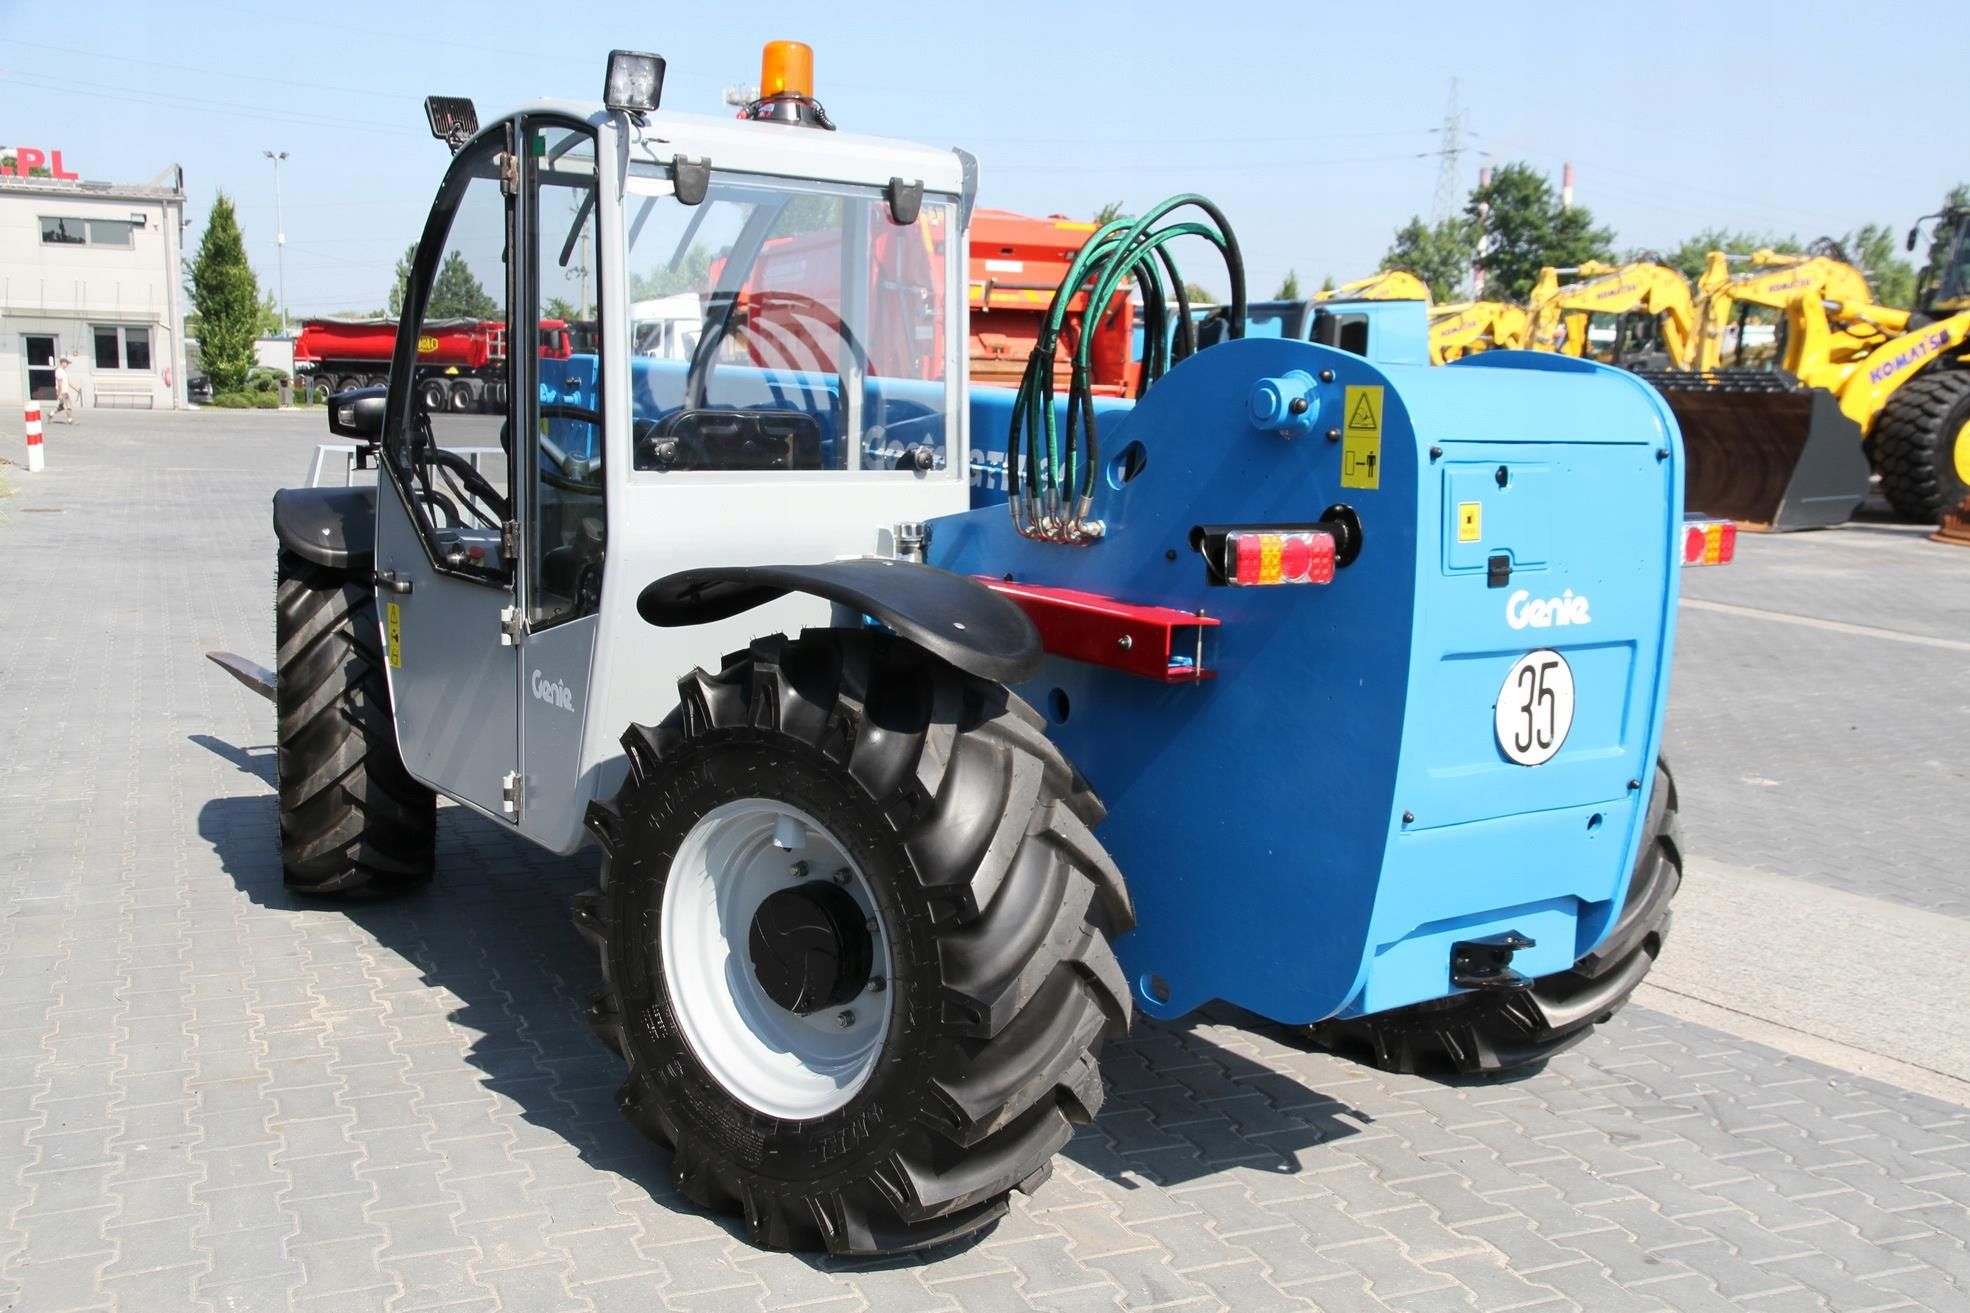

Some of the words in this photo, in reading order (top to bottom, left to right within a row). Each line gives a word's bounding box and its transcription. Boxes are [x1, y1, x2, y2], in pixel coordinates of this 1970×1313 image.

[1506, 588, 1591, 630] Genie
[532, 669, 573, 712] Genie
[1515, 661, 1559, 753] 35
